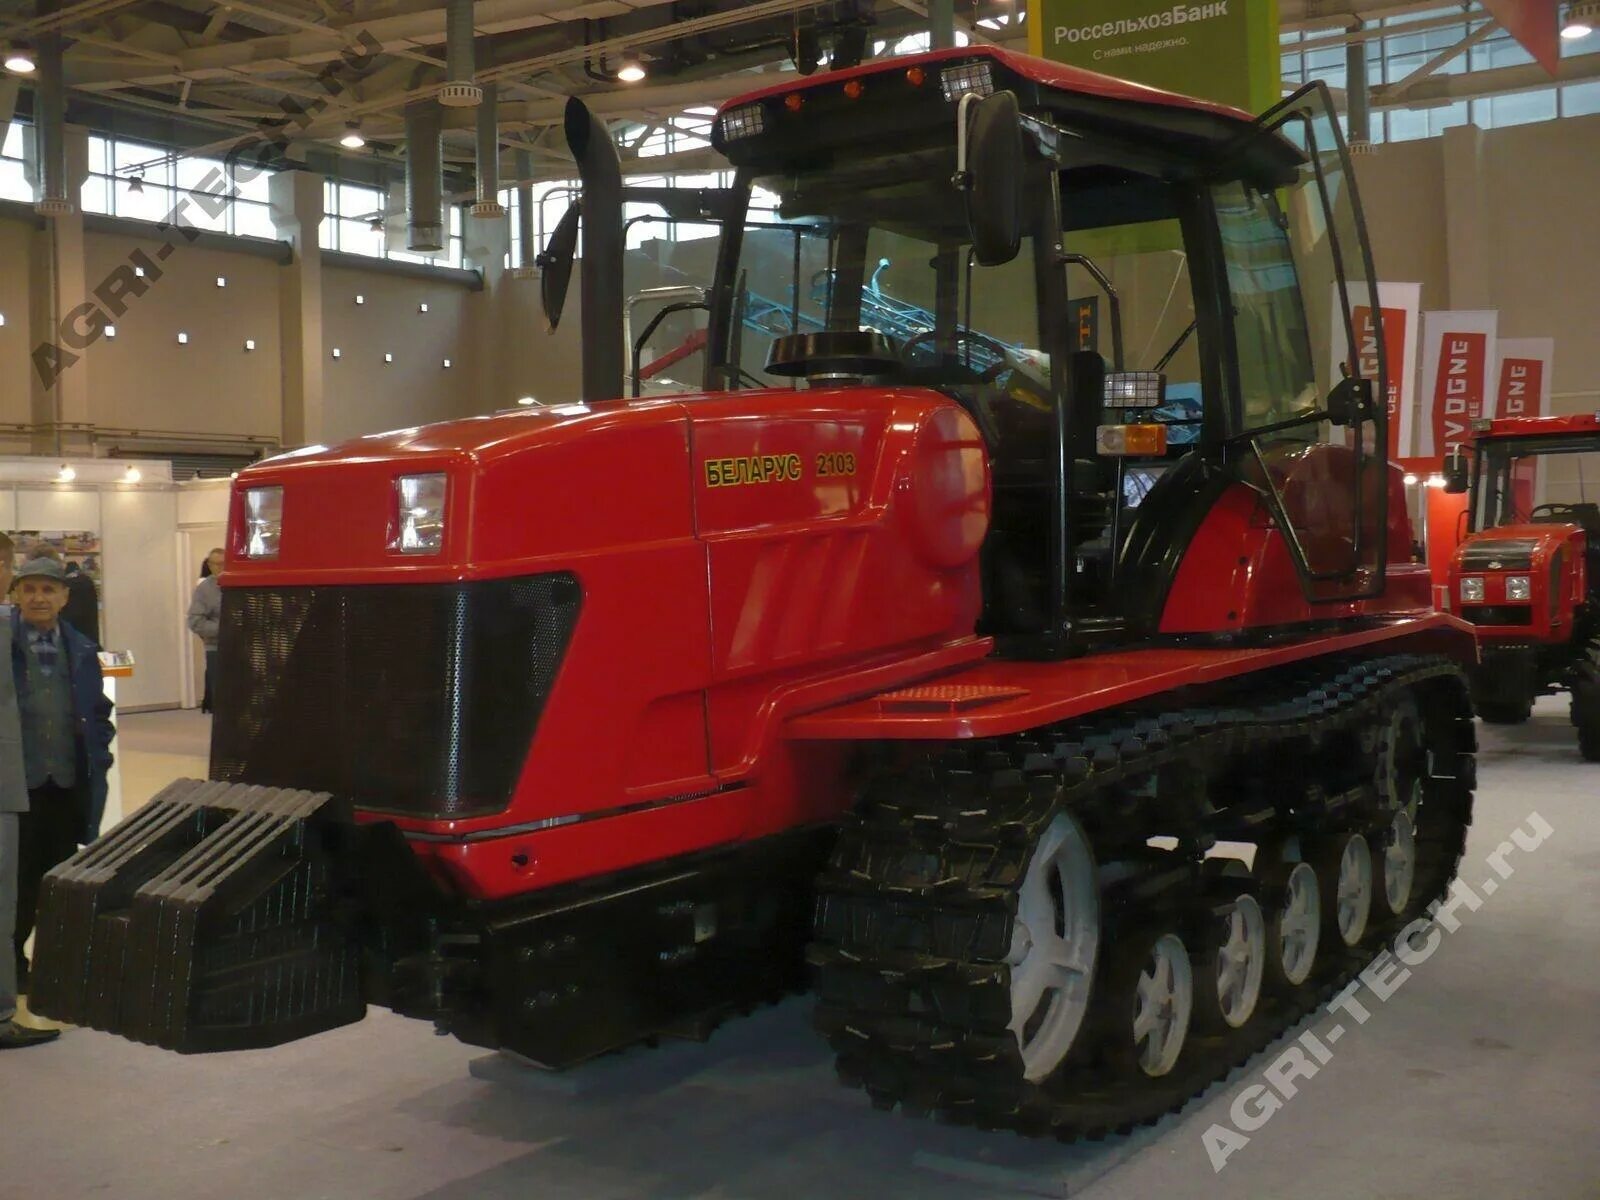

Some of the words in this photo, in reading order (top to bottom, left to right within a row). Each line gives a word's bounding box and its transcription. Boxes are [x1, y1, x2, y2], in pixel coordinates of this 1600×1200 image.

[1054, 0, 1228, 44] РоссельхозБанк
[1093, 49, 1102, 60] С
[1104, 46, 1132, 57] нами
[1359, 316, 1385, 403] GNE
[1506, 365, 1527, 416] GNE
[705, 454, 801, 487] БЕЛАРУС
[816, 452, 856, 477] 2103
